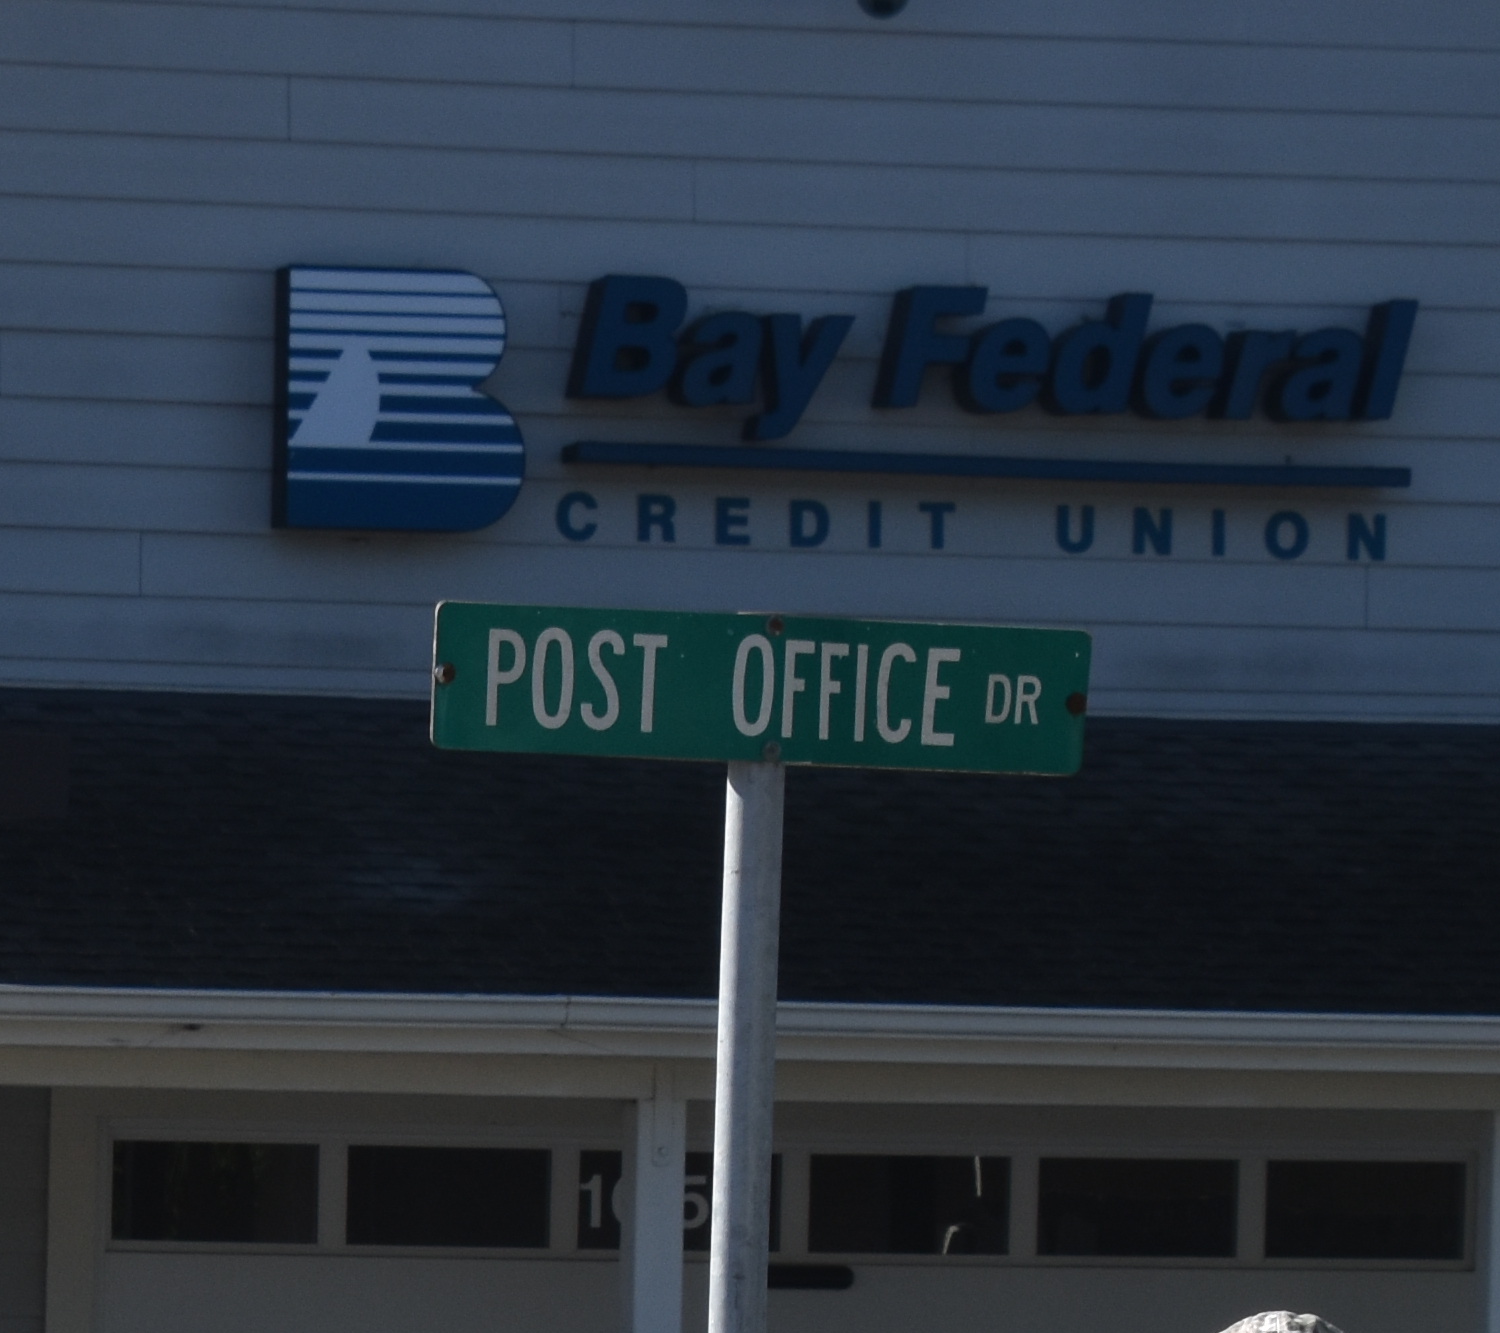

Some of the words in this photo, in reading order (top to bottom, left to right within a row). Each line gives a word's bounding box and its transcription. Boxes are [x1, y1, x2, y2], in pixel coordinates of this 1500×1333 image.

[568, 273, 853, 441] Bay
[873, 284, 1420, 423] Federal
[555, 490, 957, 549] CREDIT
[1056, 504, 1389, 562] UNION
[484, 626, 669, 733] POST
[731, 632, 963, 747] OFFICE
[983, 673, 1043, 727] DR
